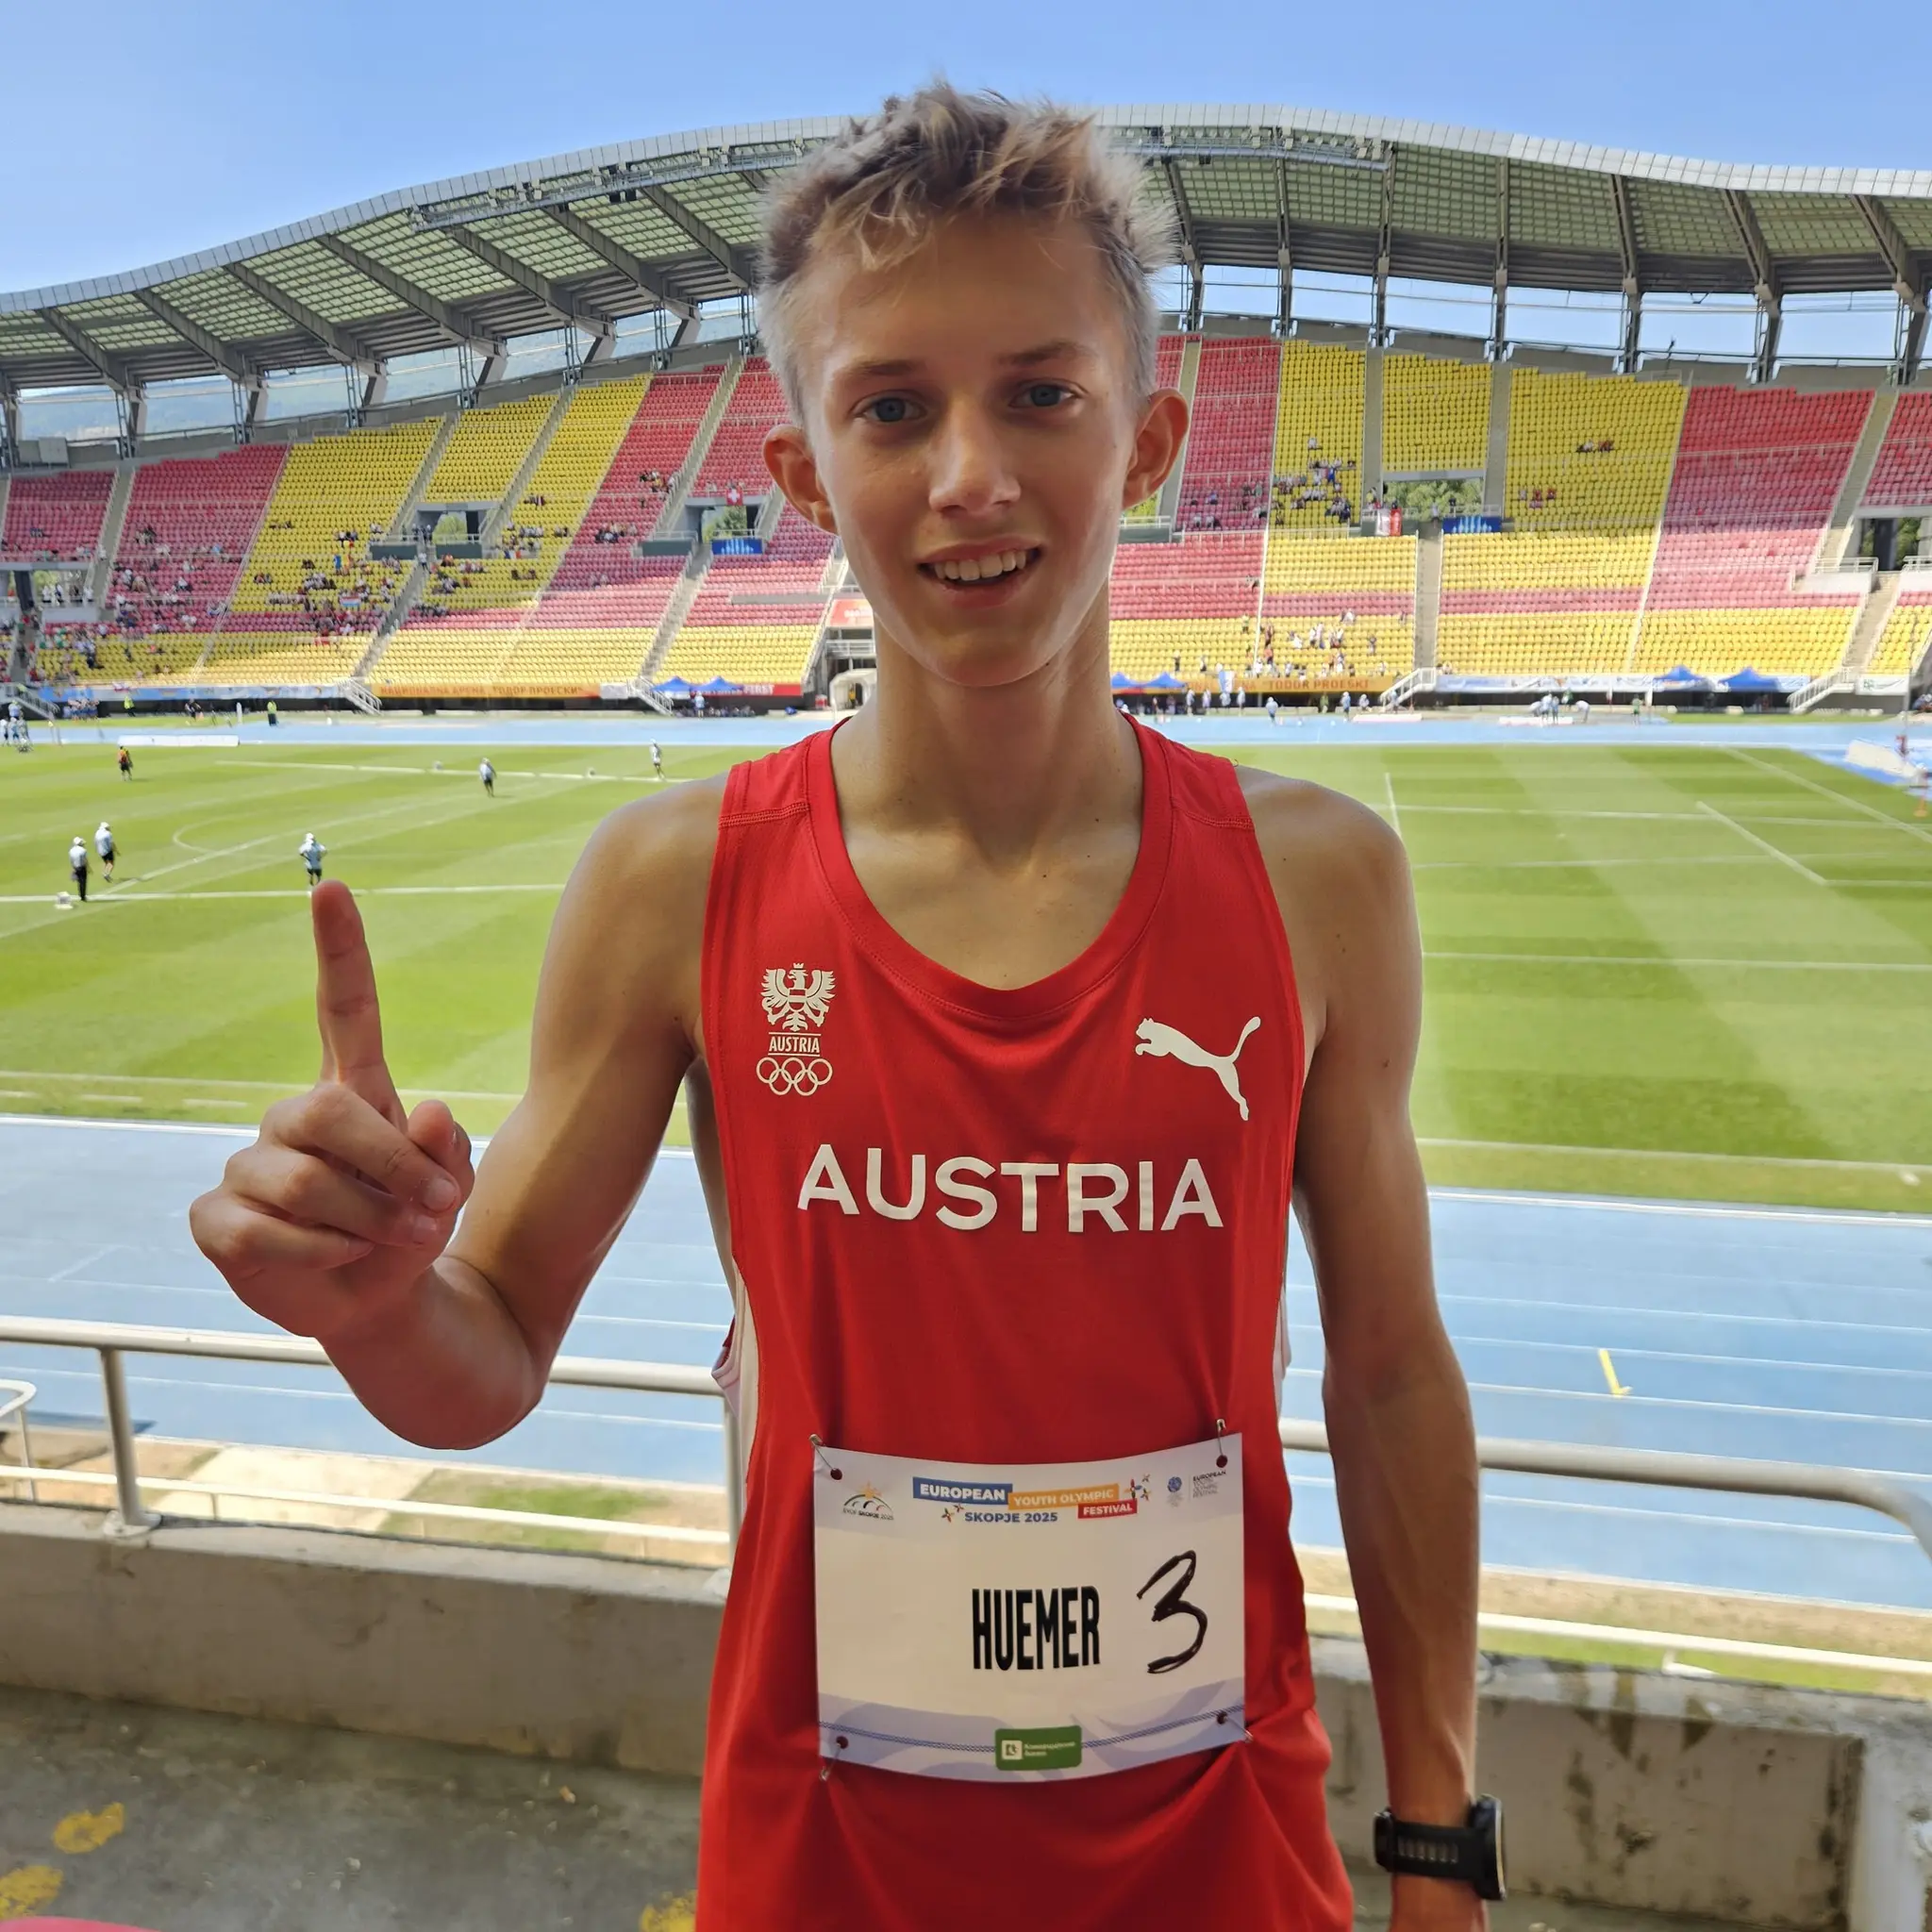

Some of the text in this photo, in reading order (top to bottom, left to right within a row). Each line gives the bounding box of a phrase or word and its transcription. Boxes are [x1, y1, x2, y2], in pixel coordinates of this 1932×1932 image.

[768, 1036, 820, 1054] AUSTRIA
[797, 1143, 1224, 1233] AUSTRIA
[920, 1483, 1006, 1501] EUROPEAN
[1014, 1489, 1114, 1507] YOUTH OLYMPIC
[964, 1511, 1058, 1524] SKOPJE 2025
[1083, 1504, 1134, 1516] FESTIVAL
[1137, 1550, 1208, 1674] 3
[972, 1585, 1101, 1671] HUEMER
